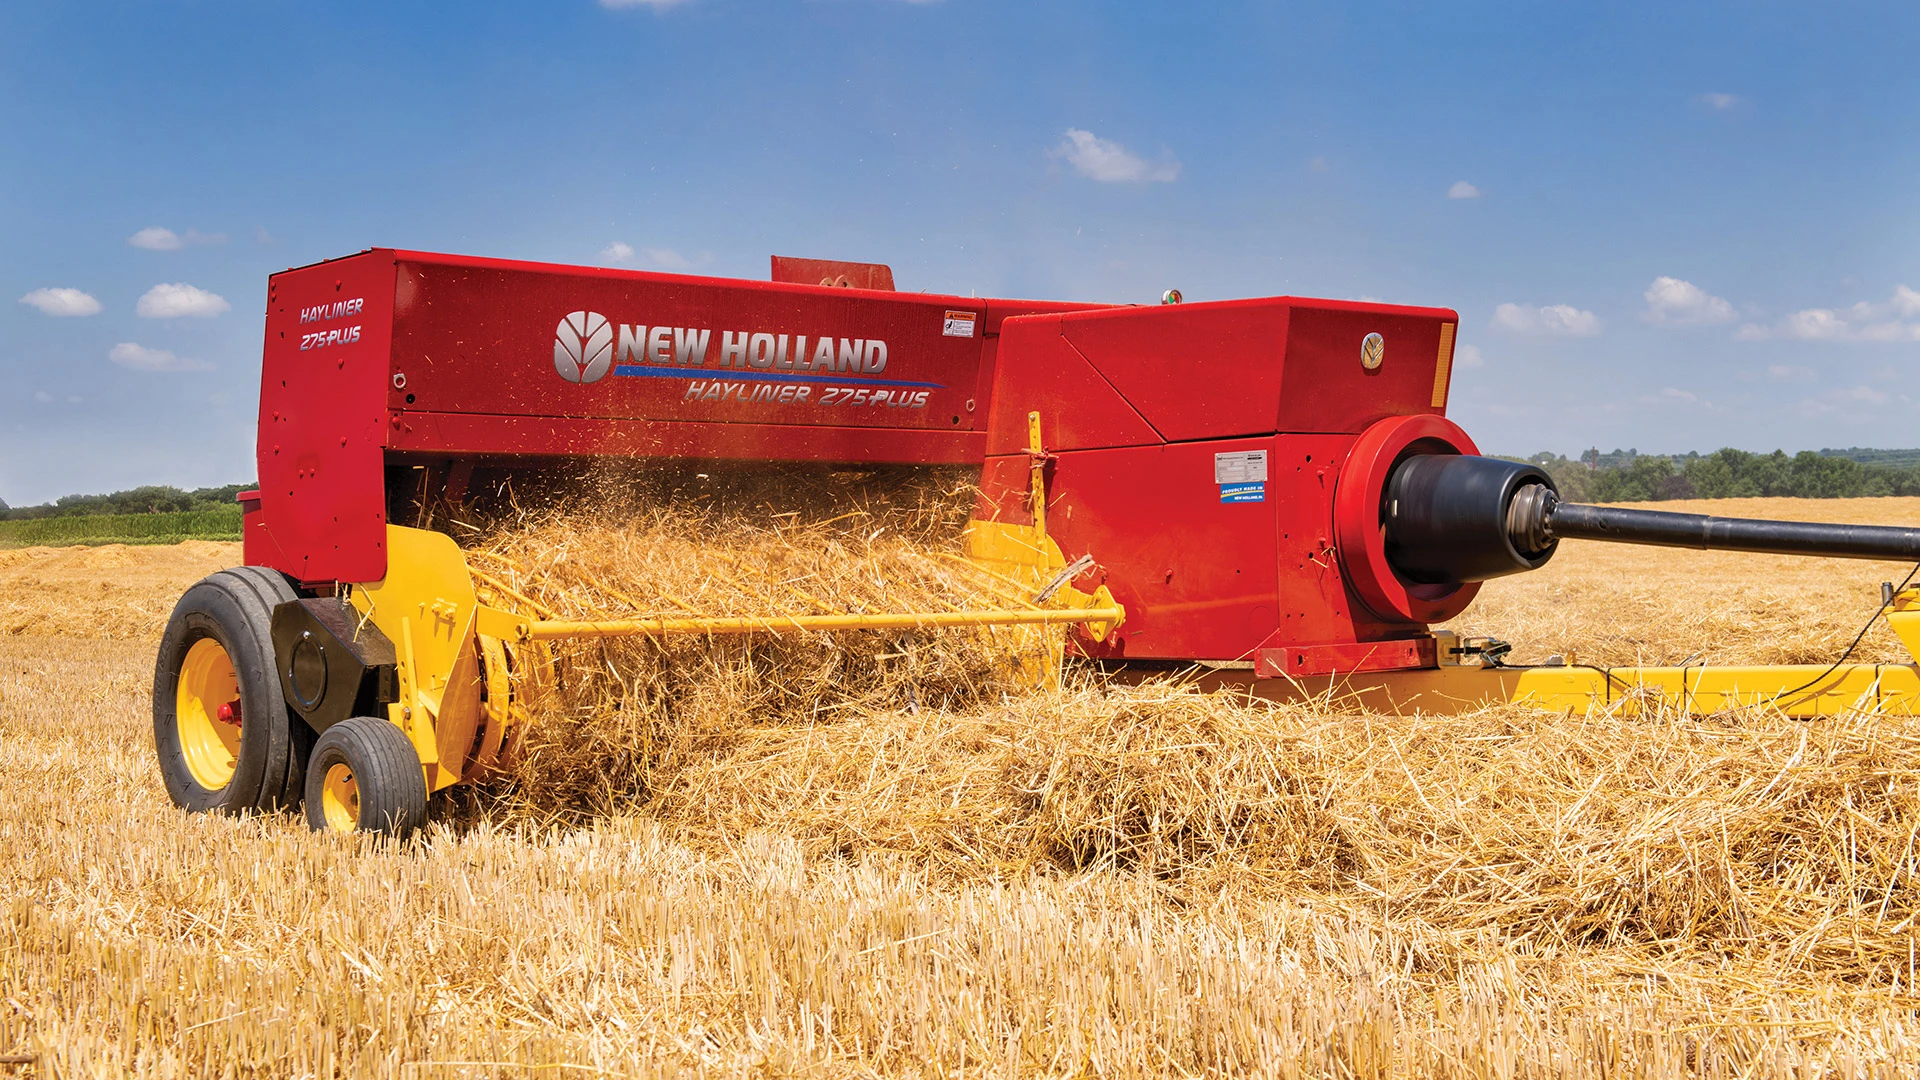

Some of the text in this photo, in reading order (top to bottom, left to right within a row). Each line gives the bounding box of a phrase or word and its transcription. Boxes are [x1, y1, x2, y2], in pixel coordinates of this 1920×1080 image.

[300, 297, 364, 324] HAYLINER
[617, 324, 889, 375] NEW HOLLAND
[684, 381, 811, 404] HAYLINER
